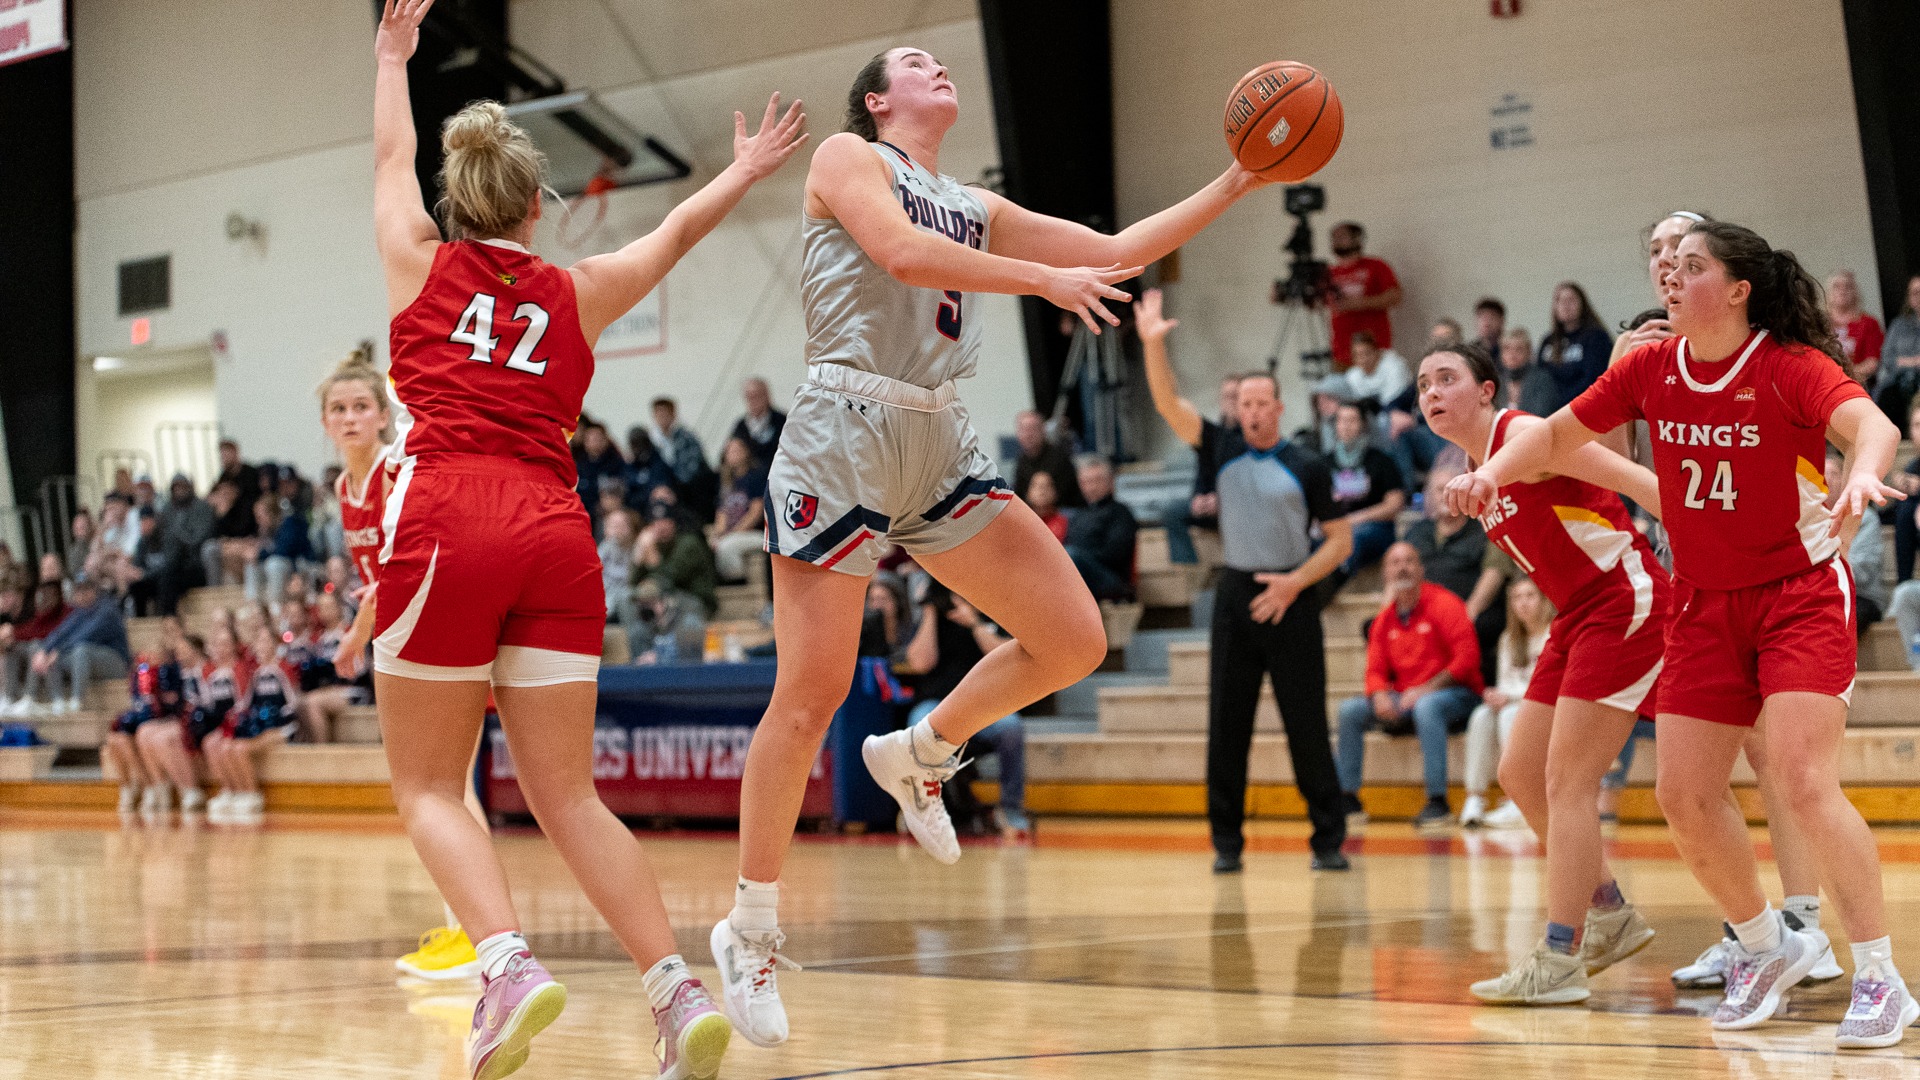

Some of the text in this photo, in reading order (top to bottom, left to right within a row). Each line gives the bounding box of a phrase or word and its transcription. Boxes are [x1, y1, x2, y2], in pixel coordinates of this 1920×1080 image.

[1226, 70, 1293, 140] THE ROCK
[1269, 119, 1288, 142] MAC
[447, 291, 550, 376] 42
[1656, 419, 1761, 448] KING'S
[1679, 458, 1739, 511] 24
